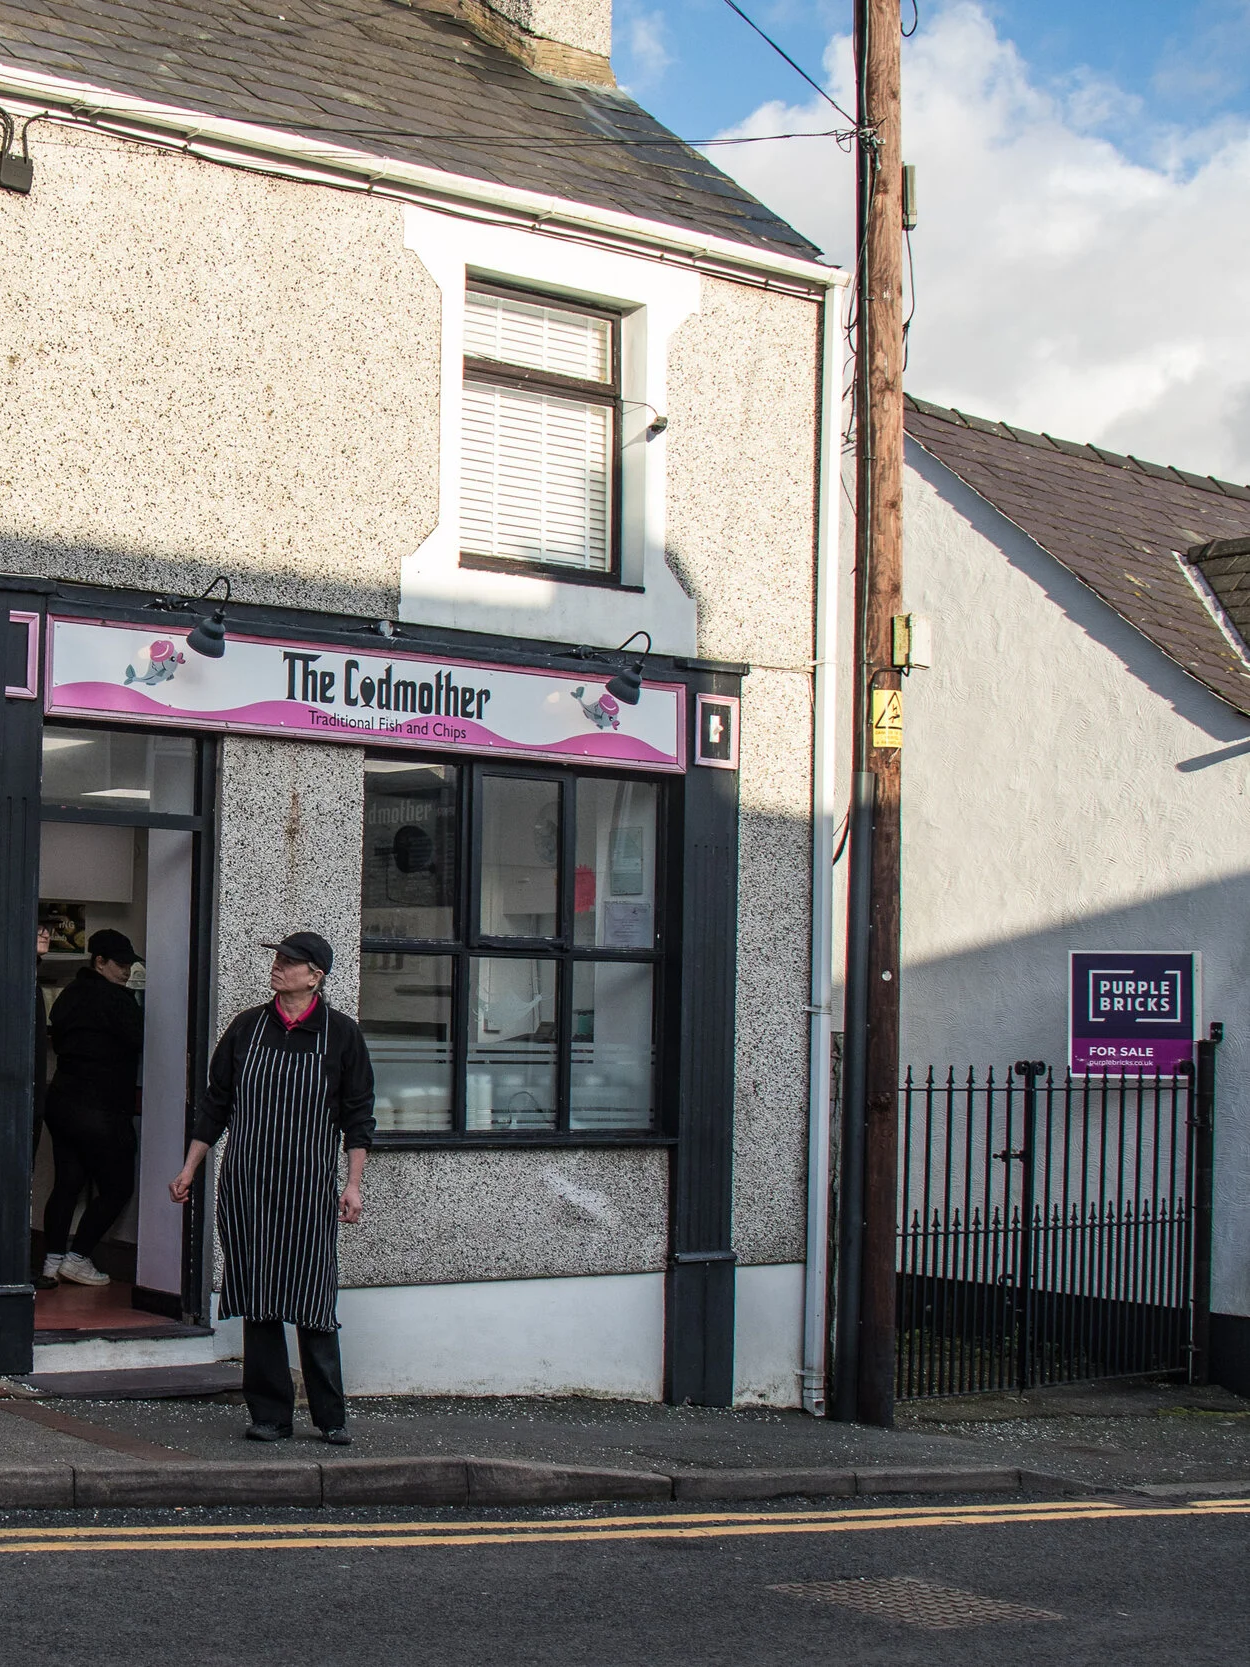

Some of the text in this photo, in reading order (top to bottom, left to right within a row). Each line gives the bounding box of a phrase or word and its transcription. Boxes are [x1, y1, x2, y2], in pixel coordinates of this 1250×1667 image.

[282, 651, 491, 720] The Codmother
[308, 710, 467, 742] Traditional Fish and Chips
[366, 799, 433, 824] dmother
[1100, 980, 1170, 995] PURPLE
[1100, 997, 1170, 1011] BRICKS
[1089, 1046, 1154, 1057] FOR SALE
[1088, 1059, 1154, 1067] purplebricks.co.uk
